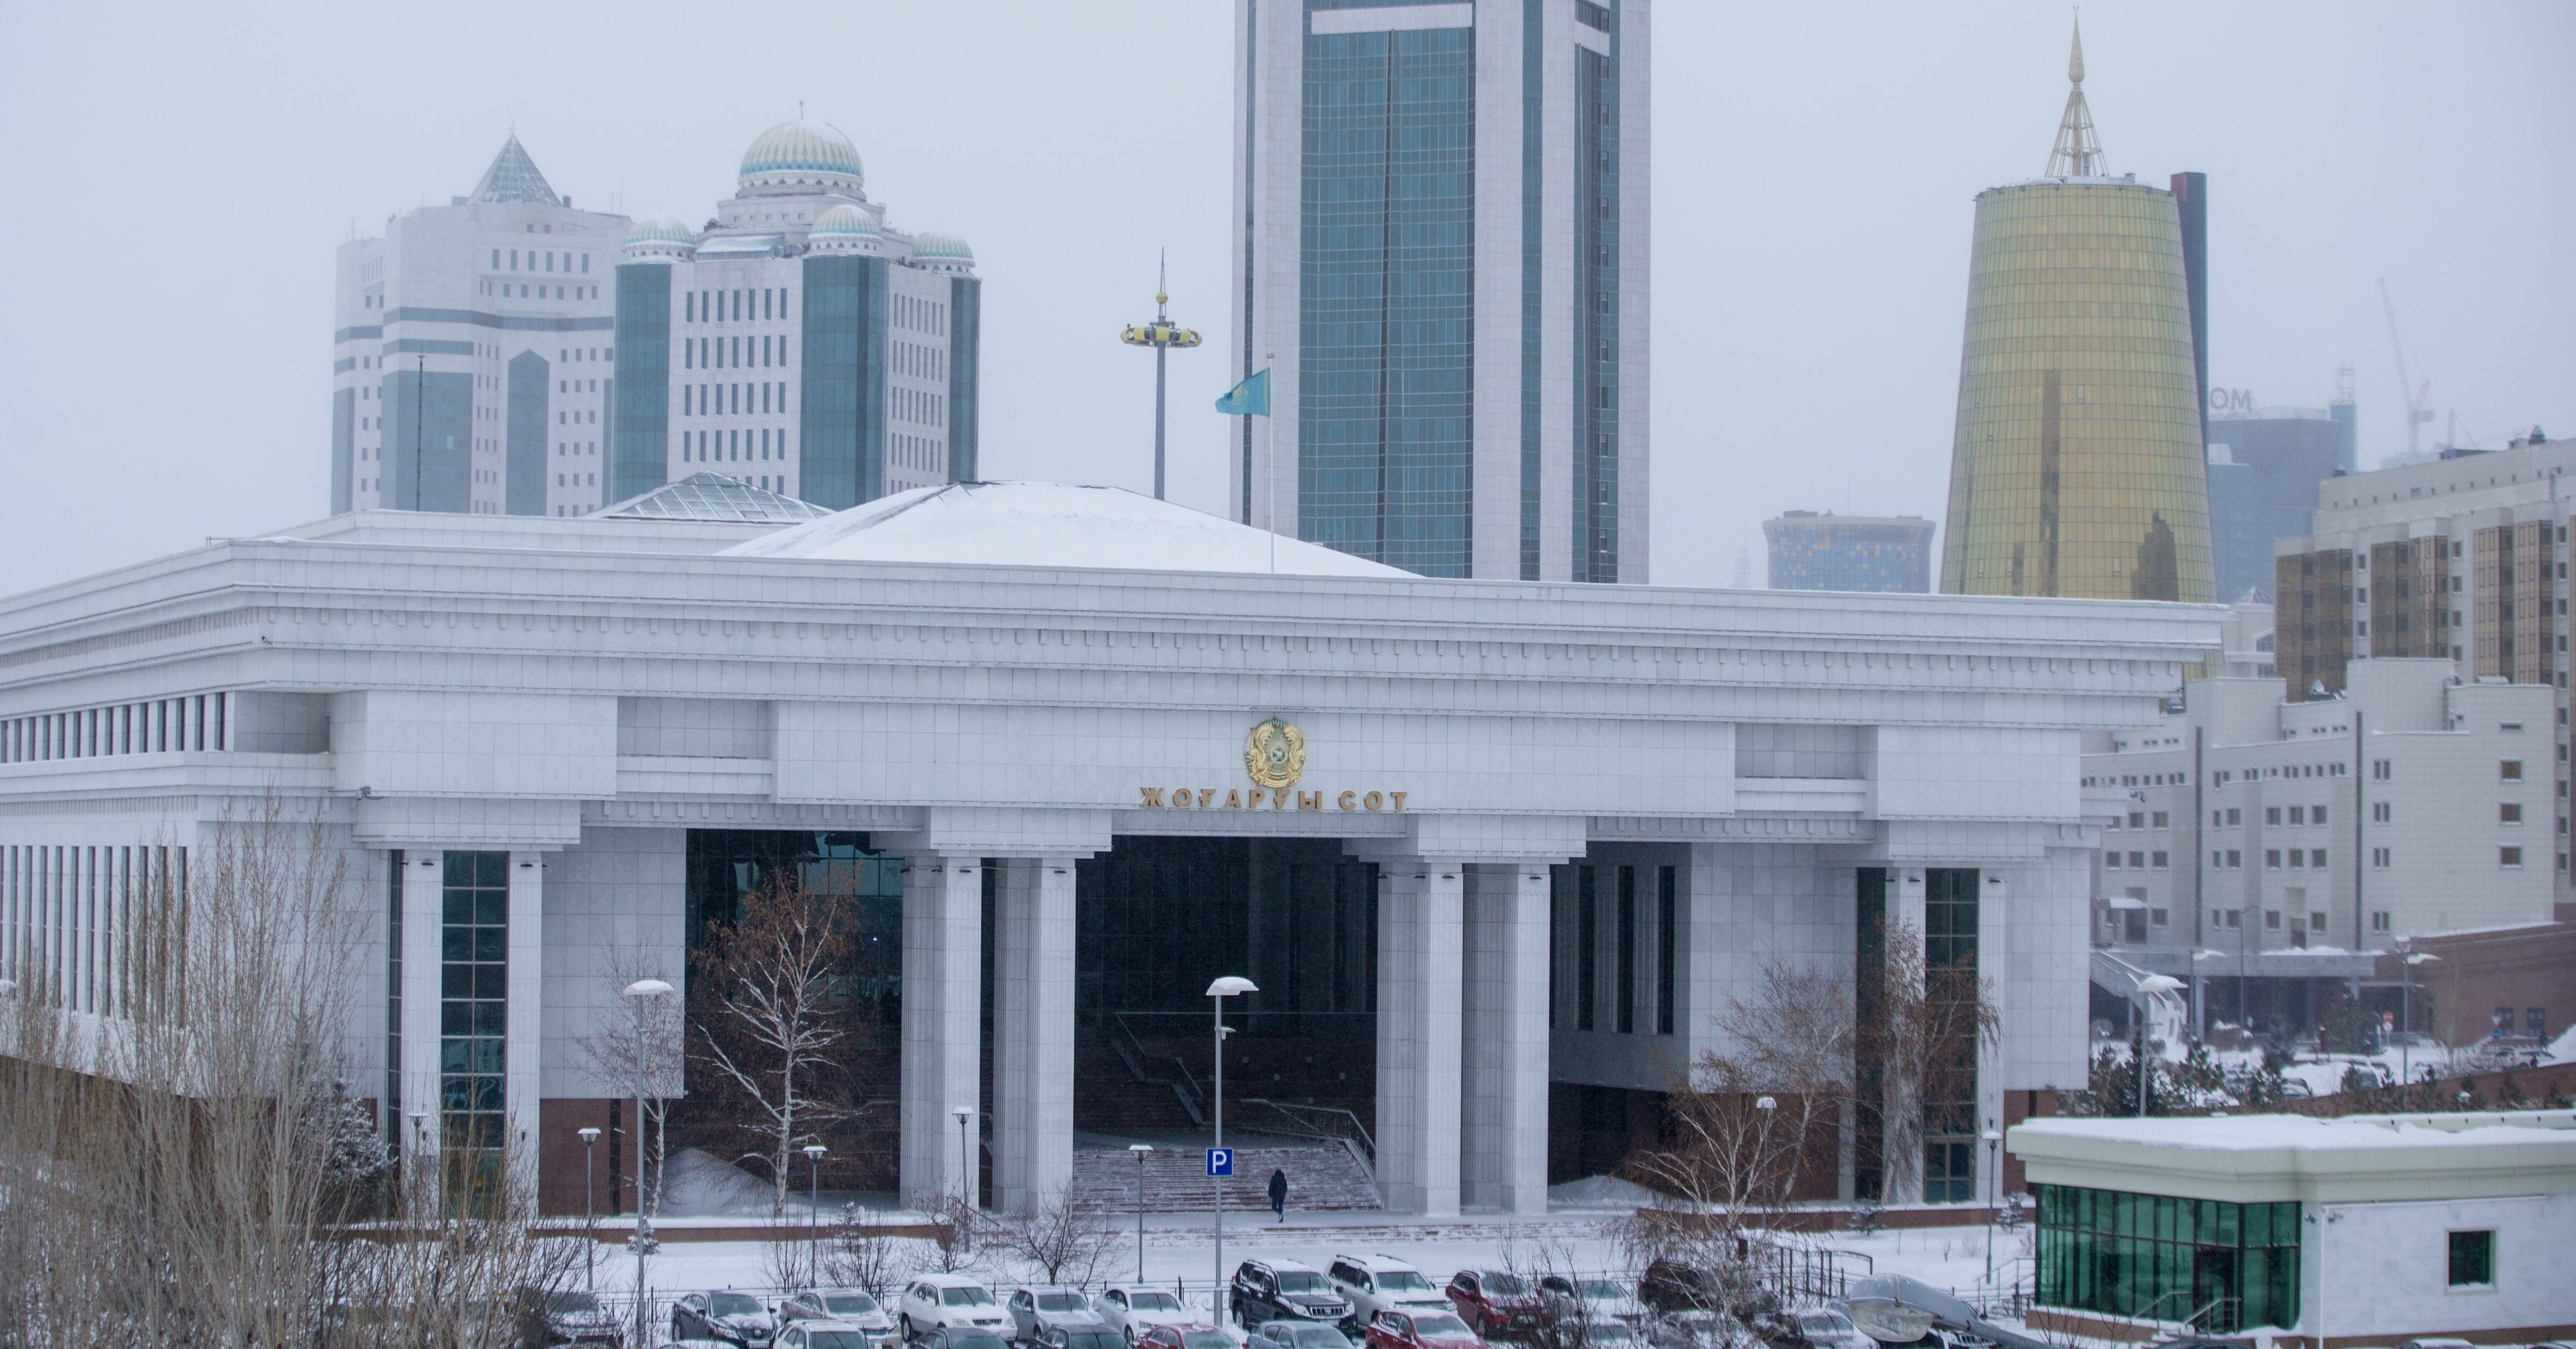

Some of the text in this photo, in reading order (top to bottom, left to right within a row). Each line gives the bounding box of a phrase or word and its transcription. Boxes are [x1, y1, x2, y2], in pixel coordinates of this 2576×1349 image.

[1140, 786, 1407, 811] ЖОҒАРҒЫ СОТ
[1213, 1151, 1227, 1174] P
